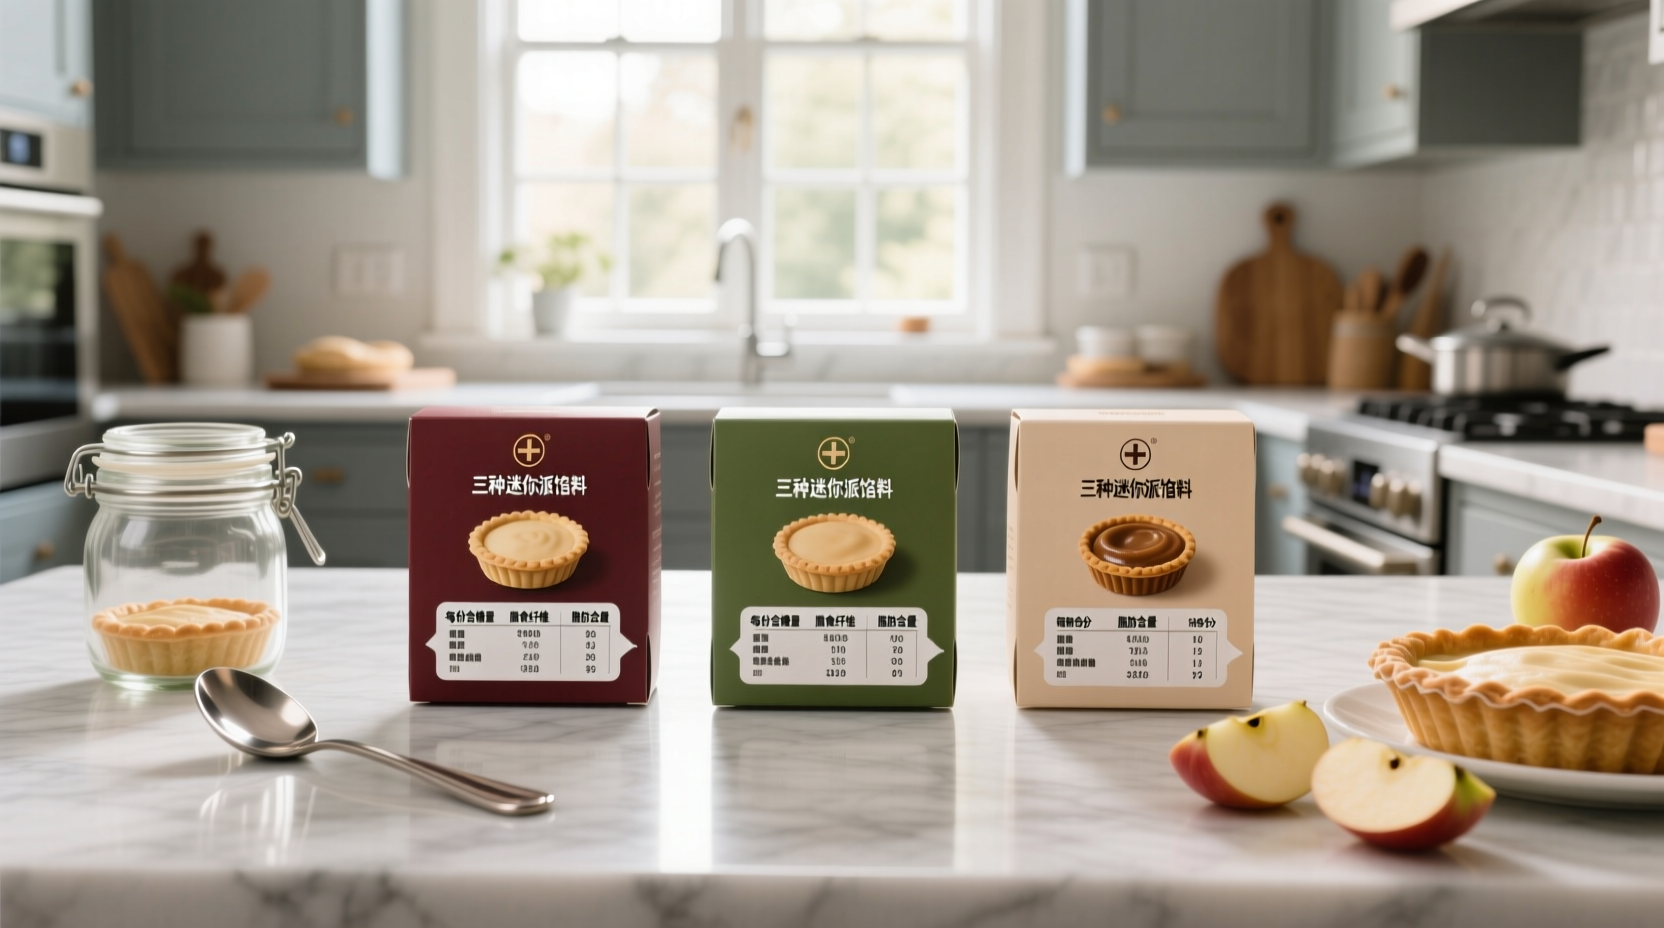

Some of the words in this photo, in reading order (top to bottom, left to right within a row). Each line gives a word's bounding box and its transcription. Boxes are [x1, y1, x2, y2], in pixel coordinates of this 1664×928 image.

[776, 478, 893, 499] 三种迷你派馅料
